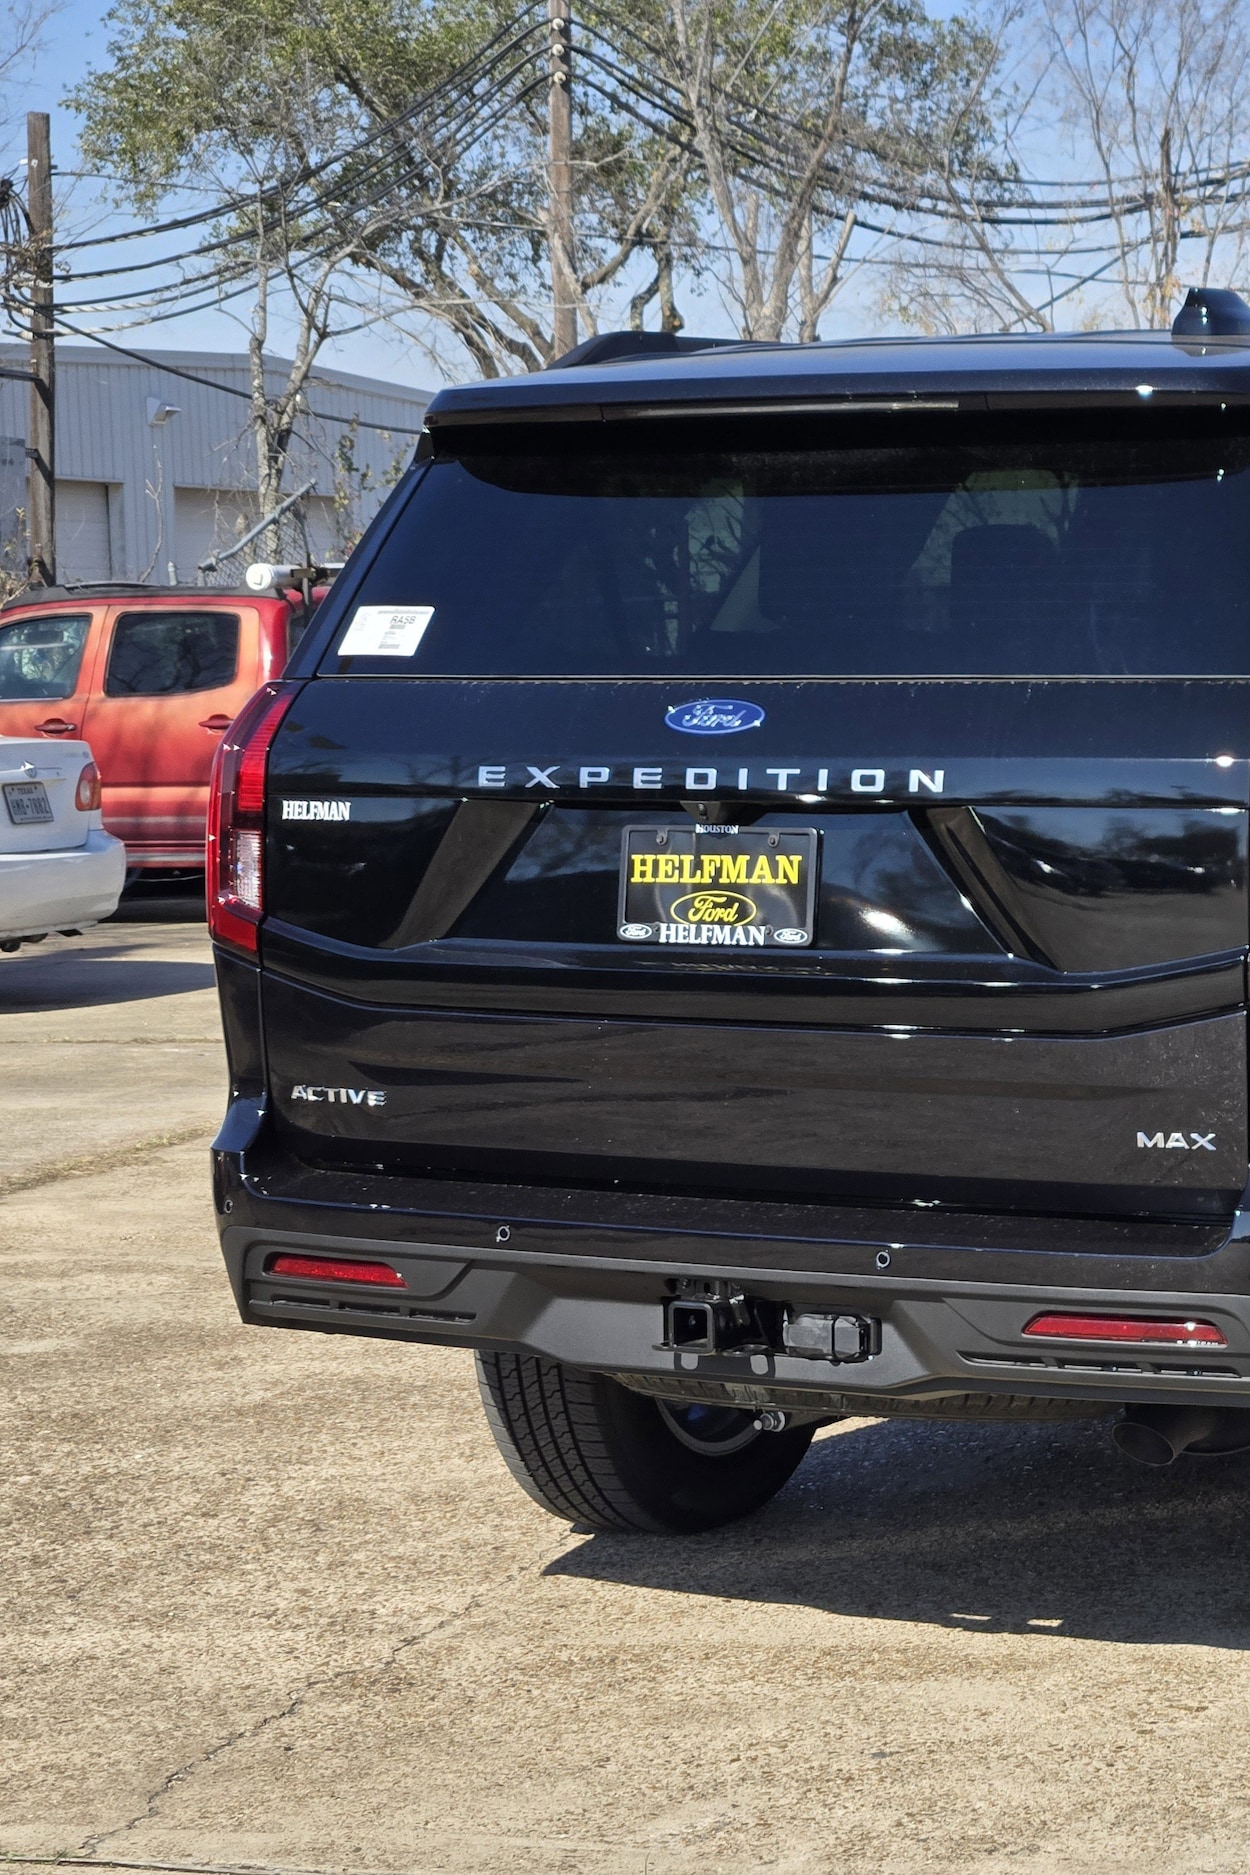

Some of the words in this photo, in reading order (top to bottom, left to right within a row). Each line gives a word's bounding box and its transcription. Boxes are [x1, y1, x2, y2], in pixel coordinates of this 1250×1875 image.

[478, 765, 945, 794] EXPEDITION
[281, 799, 352, 822] HELFMAN
[695, 823, 740, 835] HOUSTON
[630, 853, 803, 885] HELFMAN
[687, 894, 741, 923] Ford
[657, 922, 767, 947] HELFMAN
[290, 1083, 388, 1107] ACTIVE
[1136, 1131, 1217, 1151] MAX
